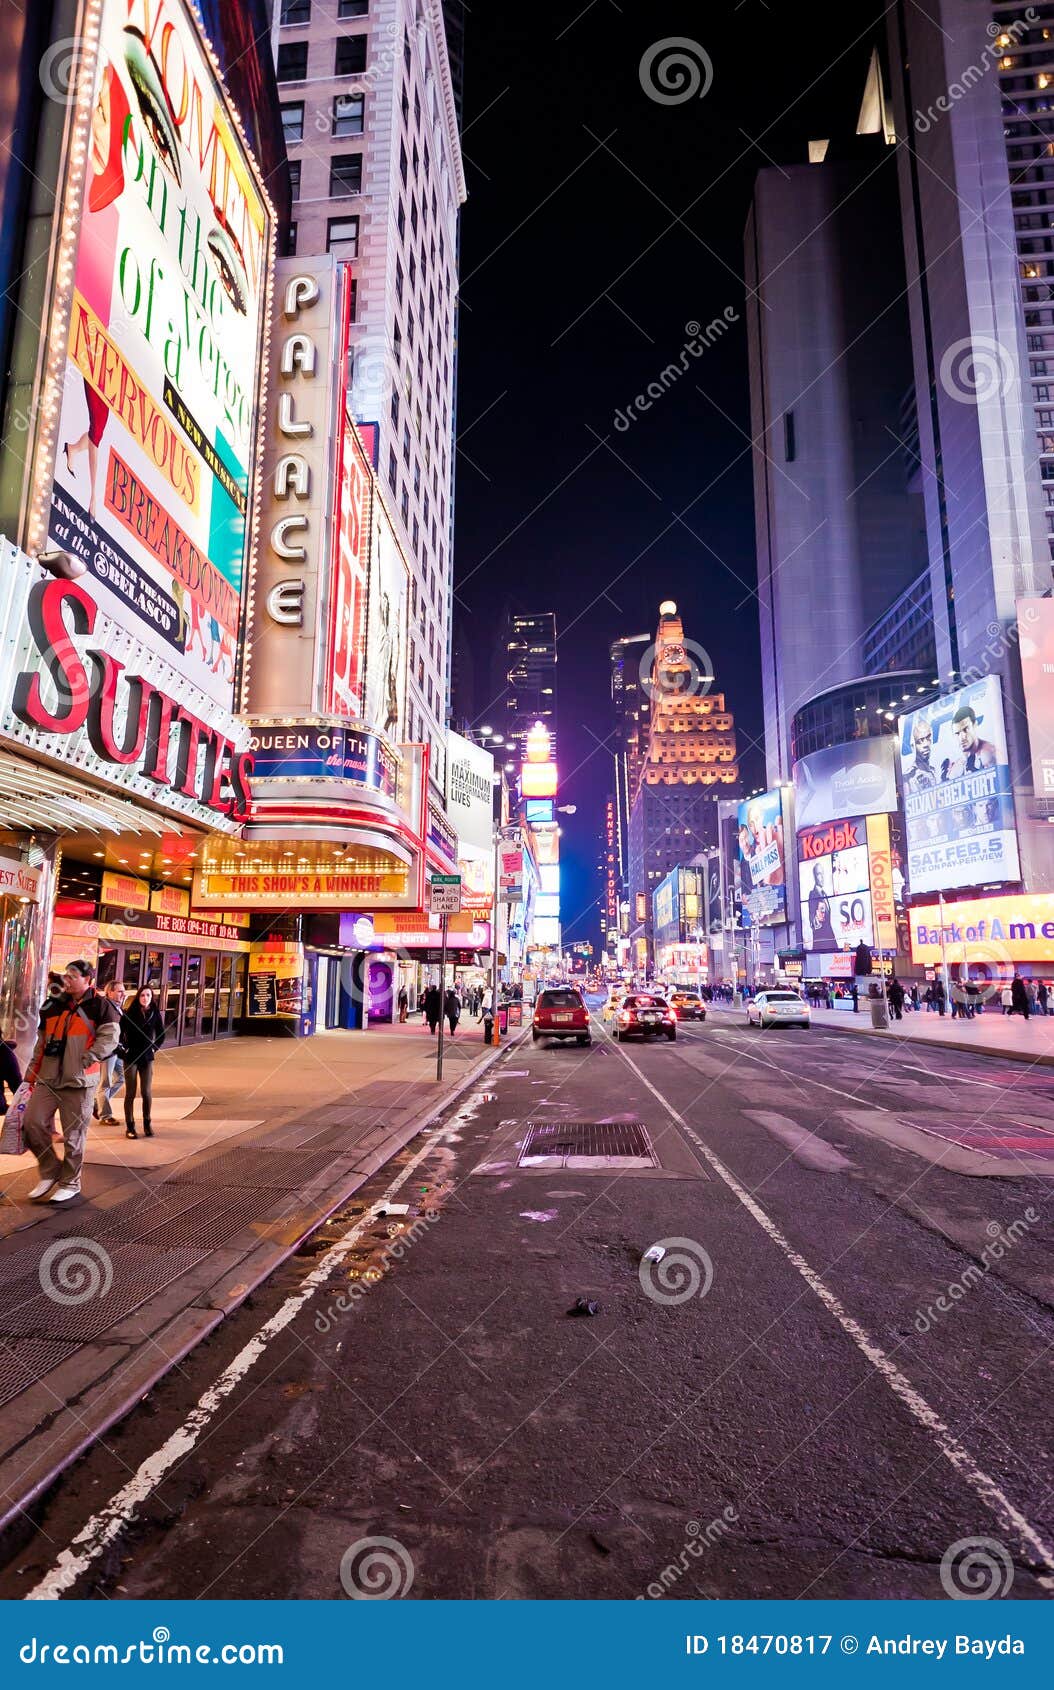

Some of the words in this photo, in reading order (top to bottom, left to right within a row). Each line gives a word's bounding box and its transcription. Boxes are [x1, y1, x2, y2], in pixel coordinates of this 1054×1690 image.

[72, 302, 200, 505] NERVOUS
[164, 388, 174, 409] A
[177, 402, 203, 448] NEW
[204, 443, 247, 515] MUSICAL
[266, 274, 319, 625] PALACE
[51, 492, 99, 547] LINCOLN
[99, 540, 138, 584] CENTER
[138, 577, 178, 620] THEATER
[109, 456, 239, 636] BREAKDOWN
[55, 523, 70, 541] at
[71, 535, 91, 559] the
[108, 561, 171, 631] BELASCO
[11, 578, 255, 823] SUITES
[249, 735, 309, 751] QUEEN
[316, 735, 343, 750] OF
[347, 738, 367, 756] TH
[326, 753, 343, 767] the
[450, 777, 491, 805] PERFORMANCE
[451, 762, 491, 794] MAXIMUM
[450, 790, 471, 808] LIVES
[606, 802, 614, 846] ERNST
[802, 823, 858, 859] Kodak
[911, 850, 943, 869] SAT.
[945, 842, 987, 863] FEB.
[988, 837, 1003, 853] 5
[942, 851, 1003, 870] PAY-PER-VIEW
[263, 876, 309, 892] SHOW'S
[314, 877, 320, 891] A
[607, 869, 615, 916] YOUNG
[870, 850, 892, 916] Kodak
[157, 915, 170, 931] THE
[172, 918, 186, 933] BOX
[436, 903, 454, 911] LANE
[917, 923, 962, 945] Bank
[966, 920, 985, 942] of
